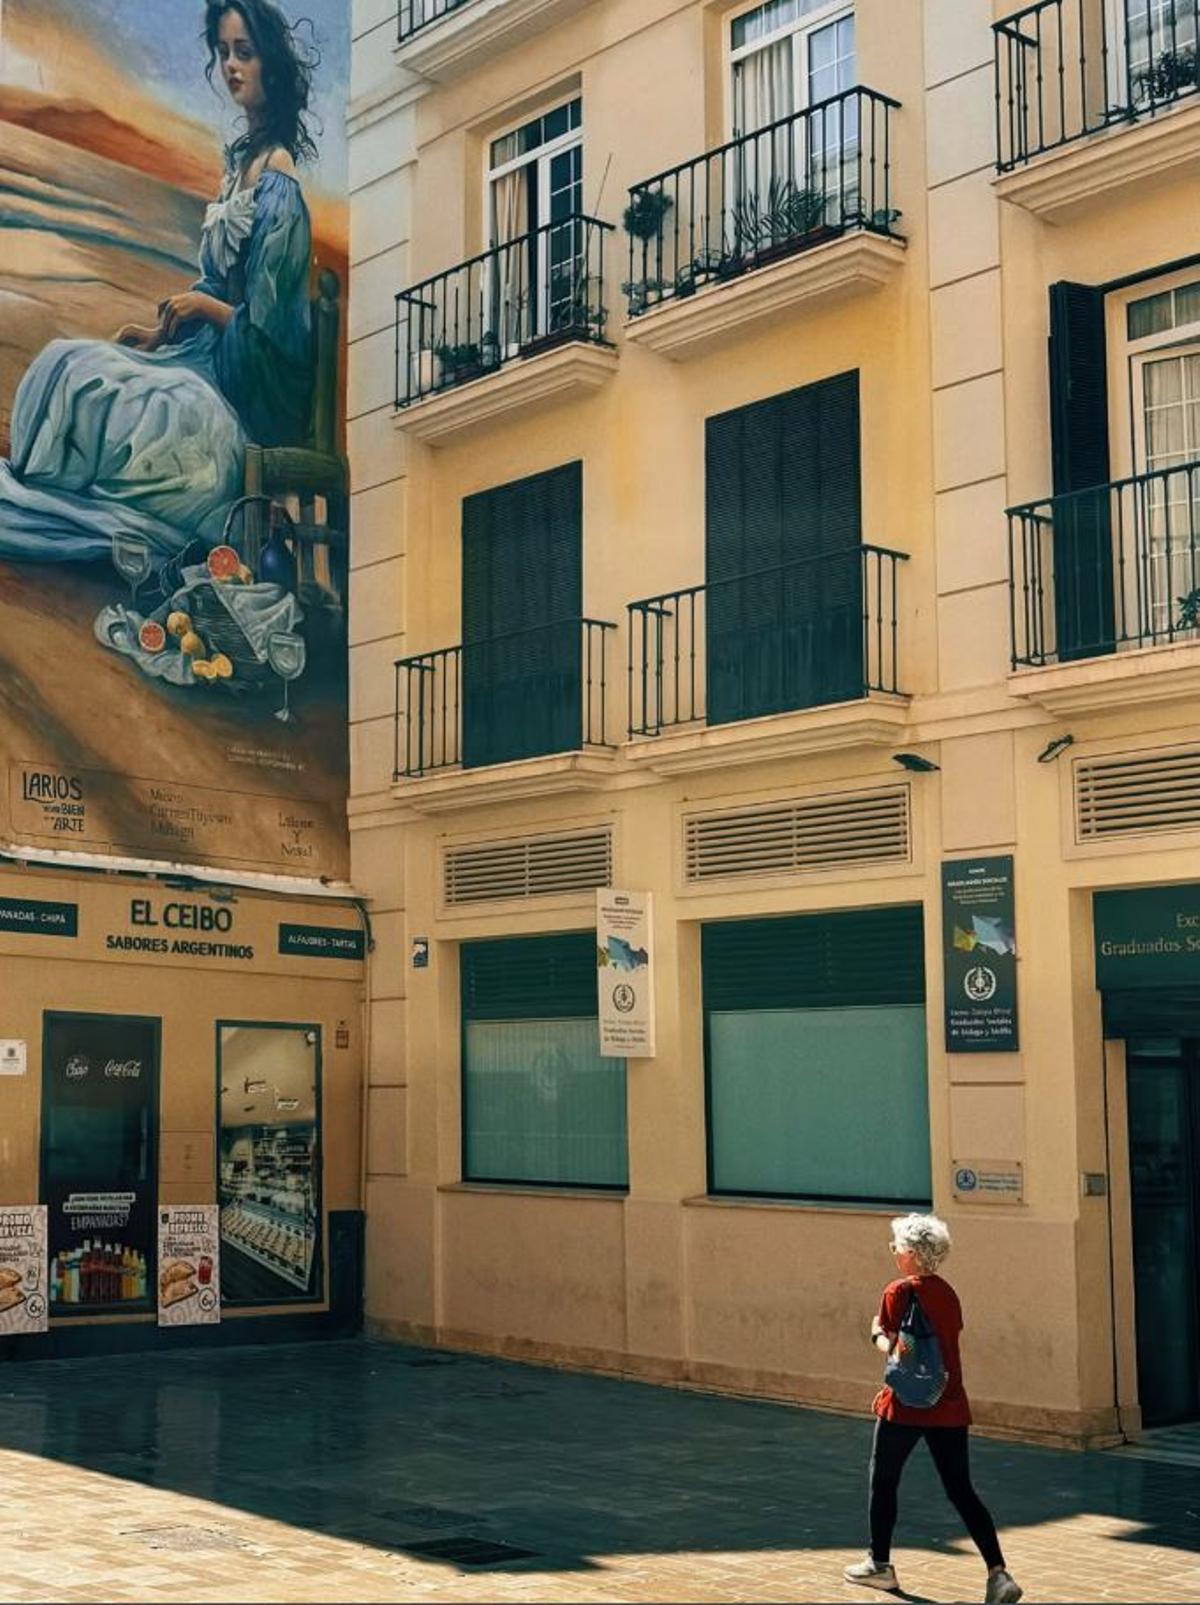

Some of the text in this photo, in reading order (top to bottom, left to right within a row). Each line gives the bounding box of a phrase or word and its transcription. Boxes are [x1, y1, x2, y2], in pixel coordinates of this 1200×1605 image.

[23, 771, 82, 803] LARIOS
[54, 816, 84, 832] ARTE
[131, 899, 233, 932] EL CEIBO
[106, 935, 254, 960] SABORES ARGENTINOS
[1102, 936, 1182, 957] Graduados
